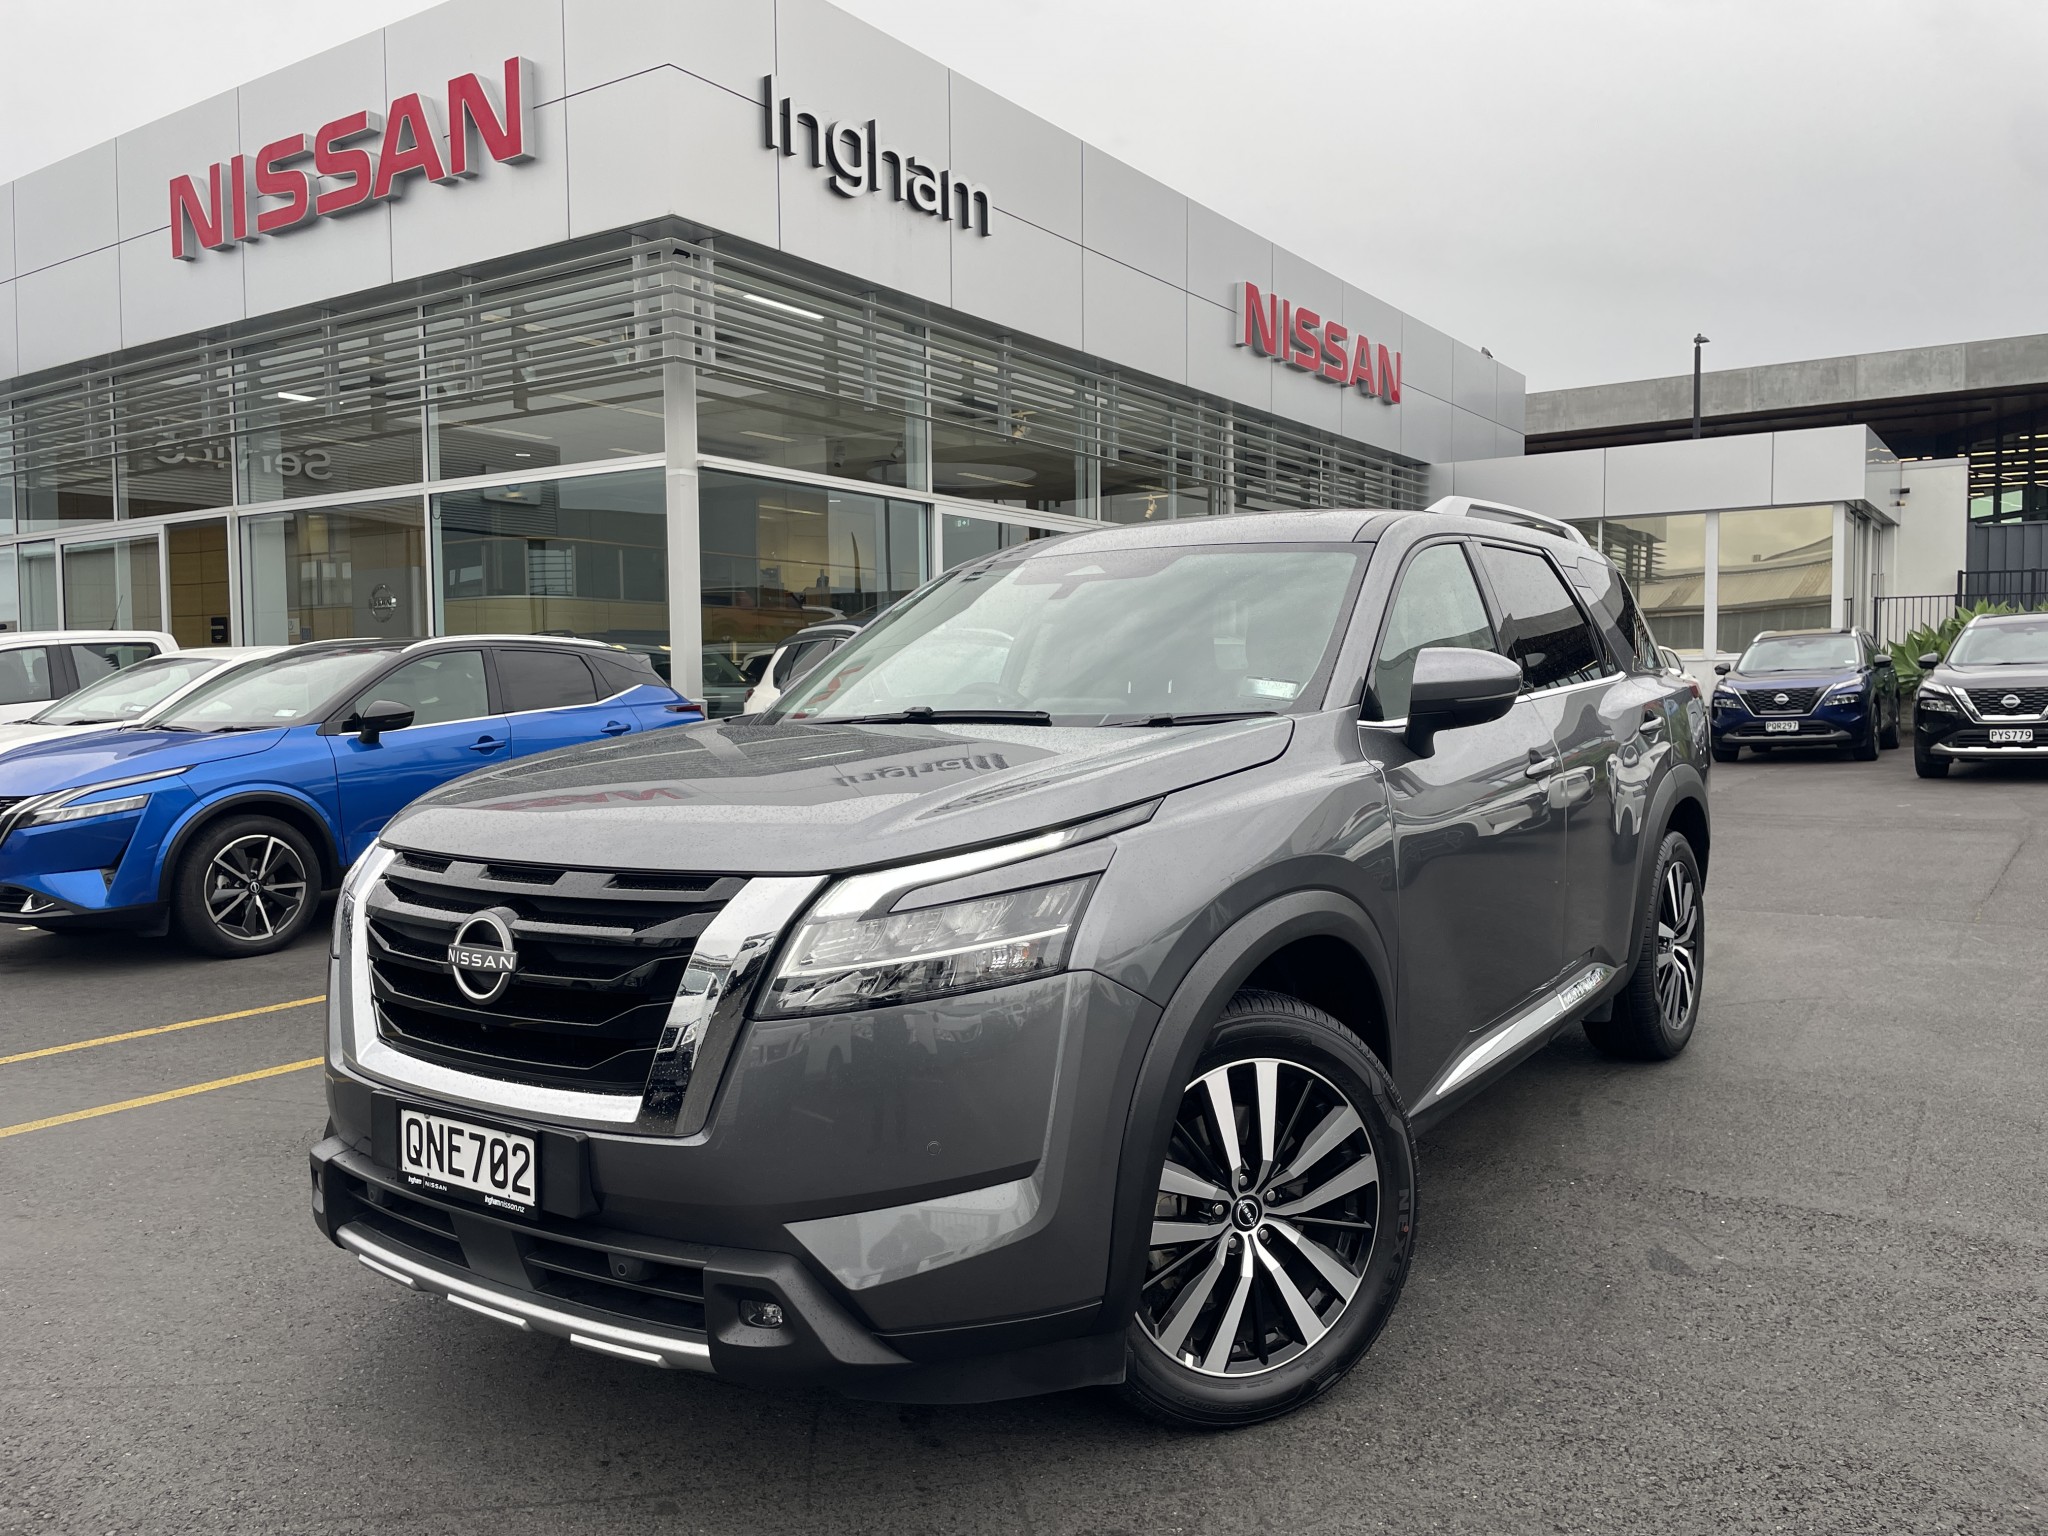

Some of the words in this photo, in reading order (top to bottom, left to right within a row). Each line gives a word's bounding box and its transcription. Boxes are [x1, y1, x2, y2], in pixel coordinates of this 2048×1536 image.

[169, 55, 530, 259] NISSAN
[763, 73, 992, 236] Ingham
[1240, 281, 1401, 404] NISSAN
[1766, 721, 1797, 730] PQR297
[1991, 730, 2032, 740] PYS779
[448, 948, 514, 970] NISSAN
[406, 1117, 531, 1196] QNE702
[425, 1181, 447, 1192] NISSAN
[1239, 1199, 1256, 1227] NISSAN
